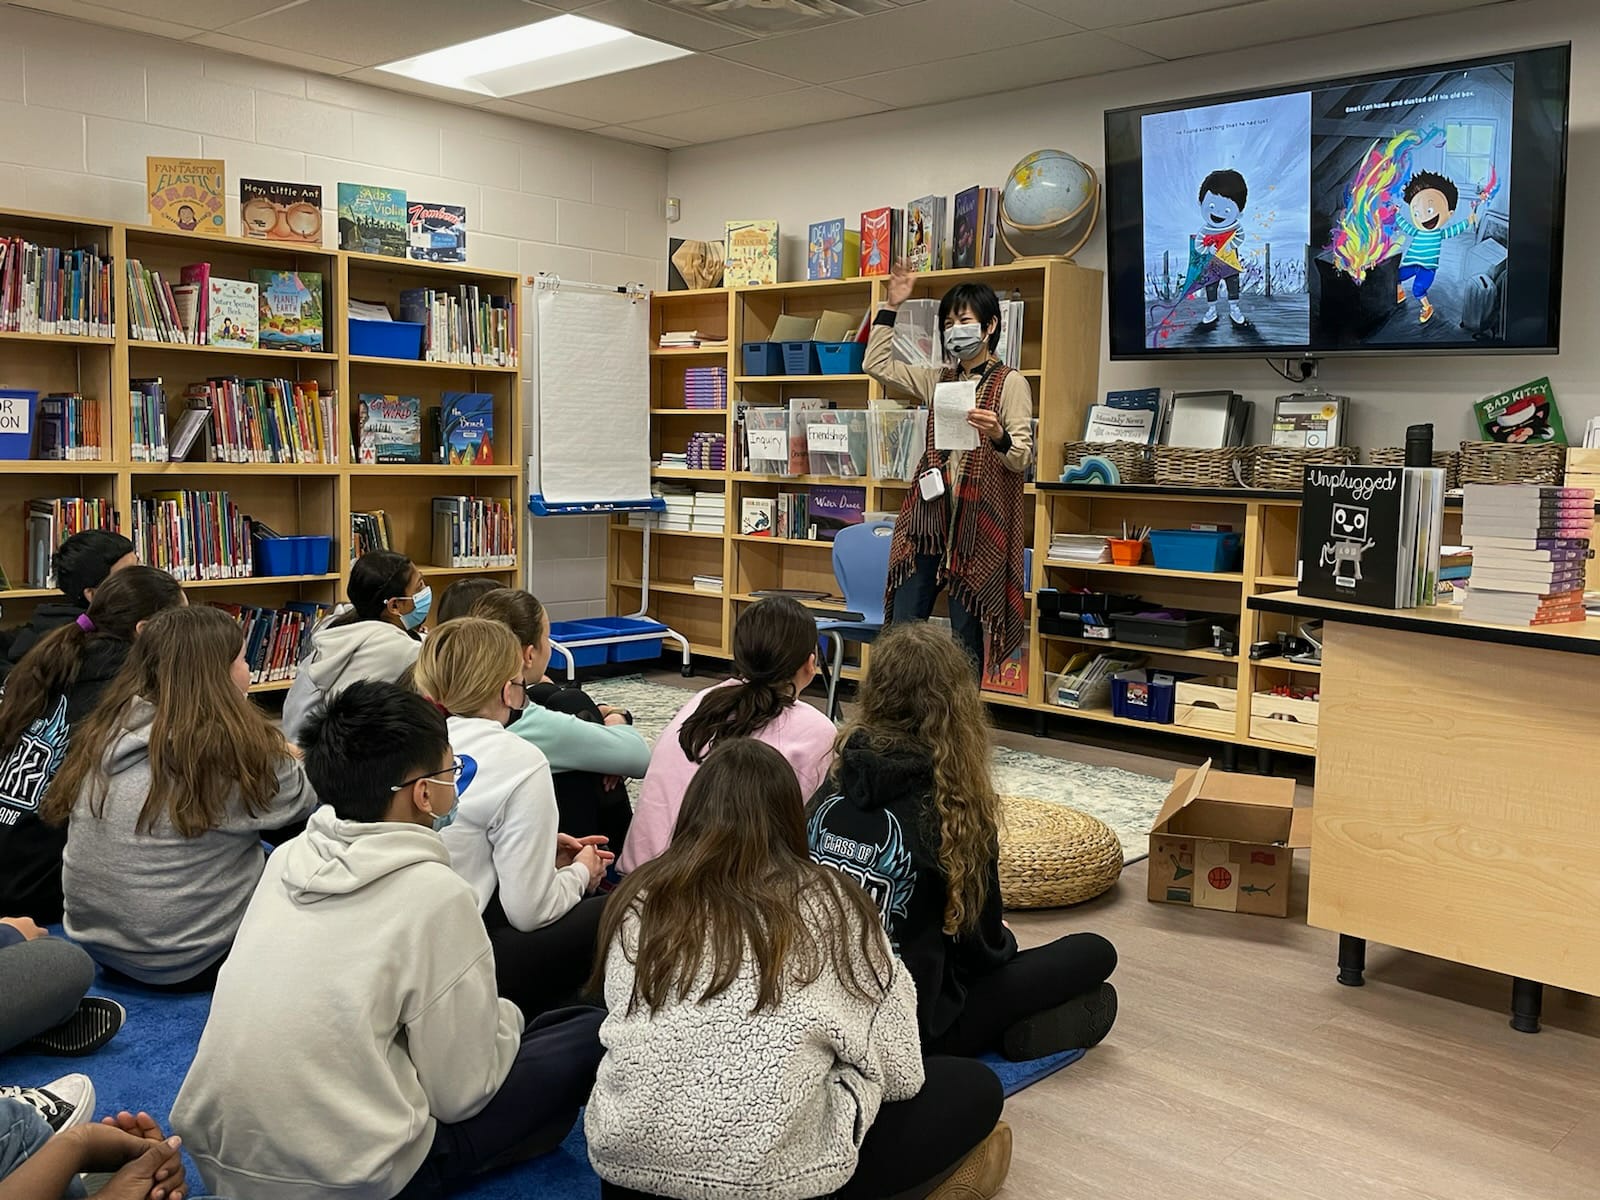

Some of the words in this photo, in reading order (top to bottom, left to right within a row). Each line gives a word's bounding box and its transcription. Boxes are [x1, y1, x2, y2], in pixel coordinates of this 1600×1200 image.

[1404, 97, 1426, 106] dusted
[1427, 94, 1439, 102] off
[154, 164, 217, 175] FANTASTIC
[155, 174, 217, 196] ELASTIC
[244, 183, 266, 195] Hey,
[270, 186, 297, 196] Little
[301, 189, 320, 198] Ant
[372, 201, 405, 217] Violin
[273, 294, 299, 304] PLANET
[276, 303, 298, 313] EARTH
[1483, 395, 1510, 413] BAD
[1512, 384, 1548, 402] KITTY
[1126, 416, 1144, 425] News
[749, 432, 782, 450] Inquiry
[808, 426, 849, 446] Friendships
[1307, 469, 1396, 500] Unplugged
[814, 496, 838, 509] Water
[839, 494, 861, 510] Dance
[824, 834, 856, 859] CLASS
[857, 845, 874, 862] OF
